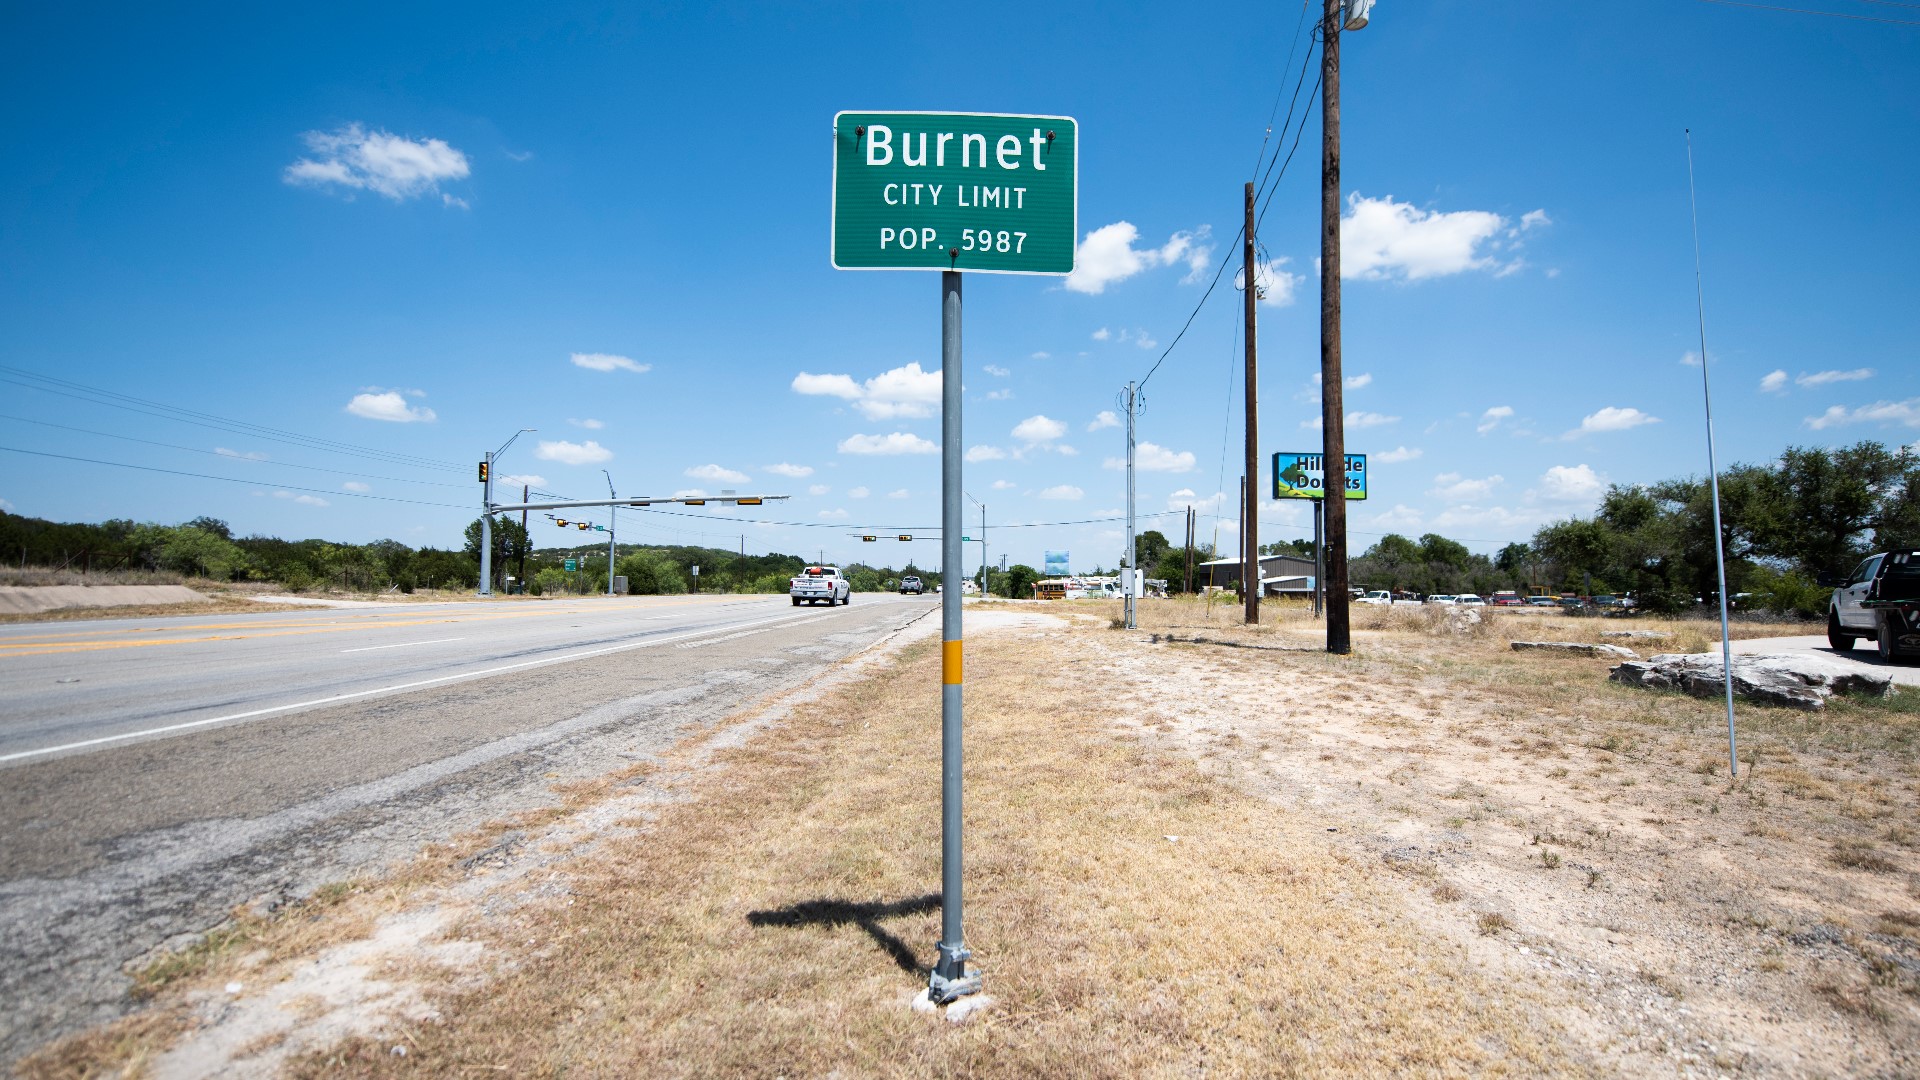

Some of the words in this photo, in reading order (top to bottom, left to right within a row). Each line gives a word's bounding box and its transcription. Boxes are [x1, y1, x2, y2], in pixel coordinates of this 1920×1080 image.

[867, 125, 1046, 170] Burnet
[884, 184, 942, 205] CITY
[959, 185, 1026, 208] LIMIT
[881, 228, 943, 249] POP.
[962, 229, 1026, 253] 5987
[1296, 456, 1363, 472] Hillde
[1296, 474, 1361, 490] Dots
